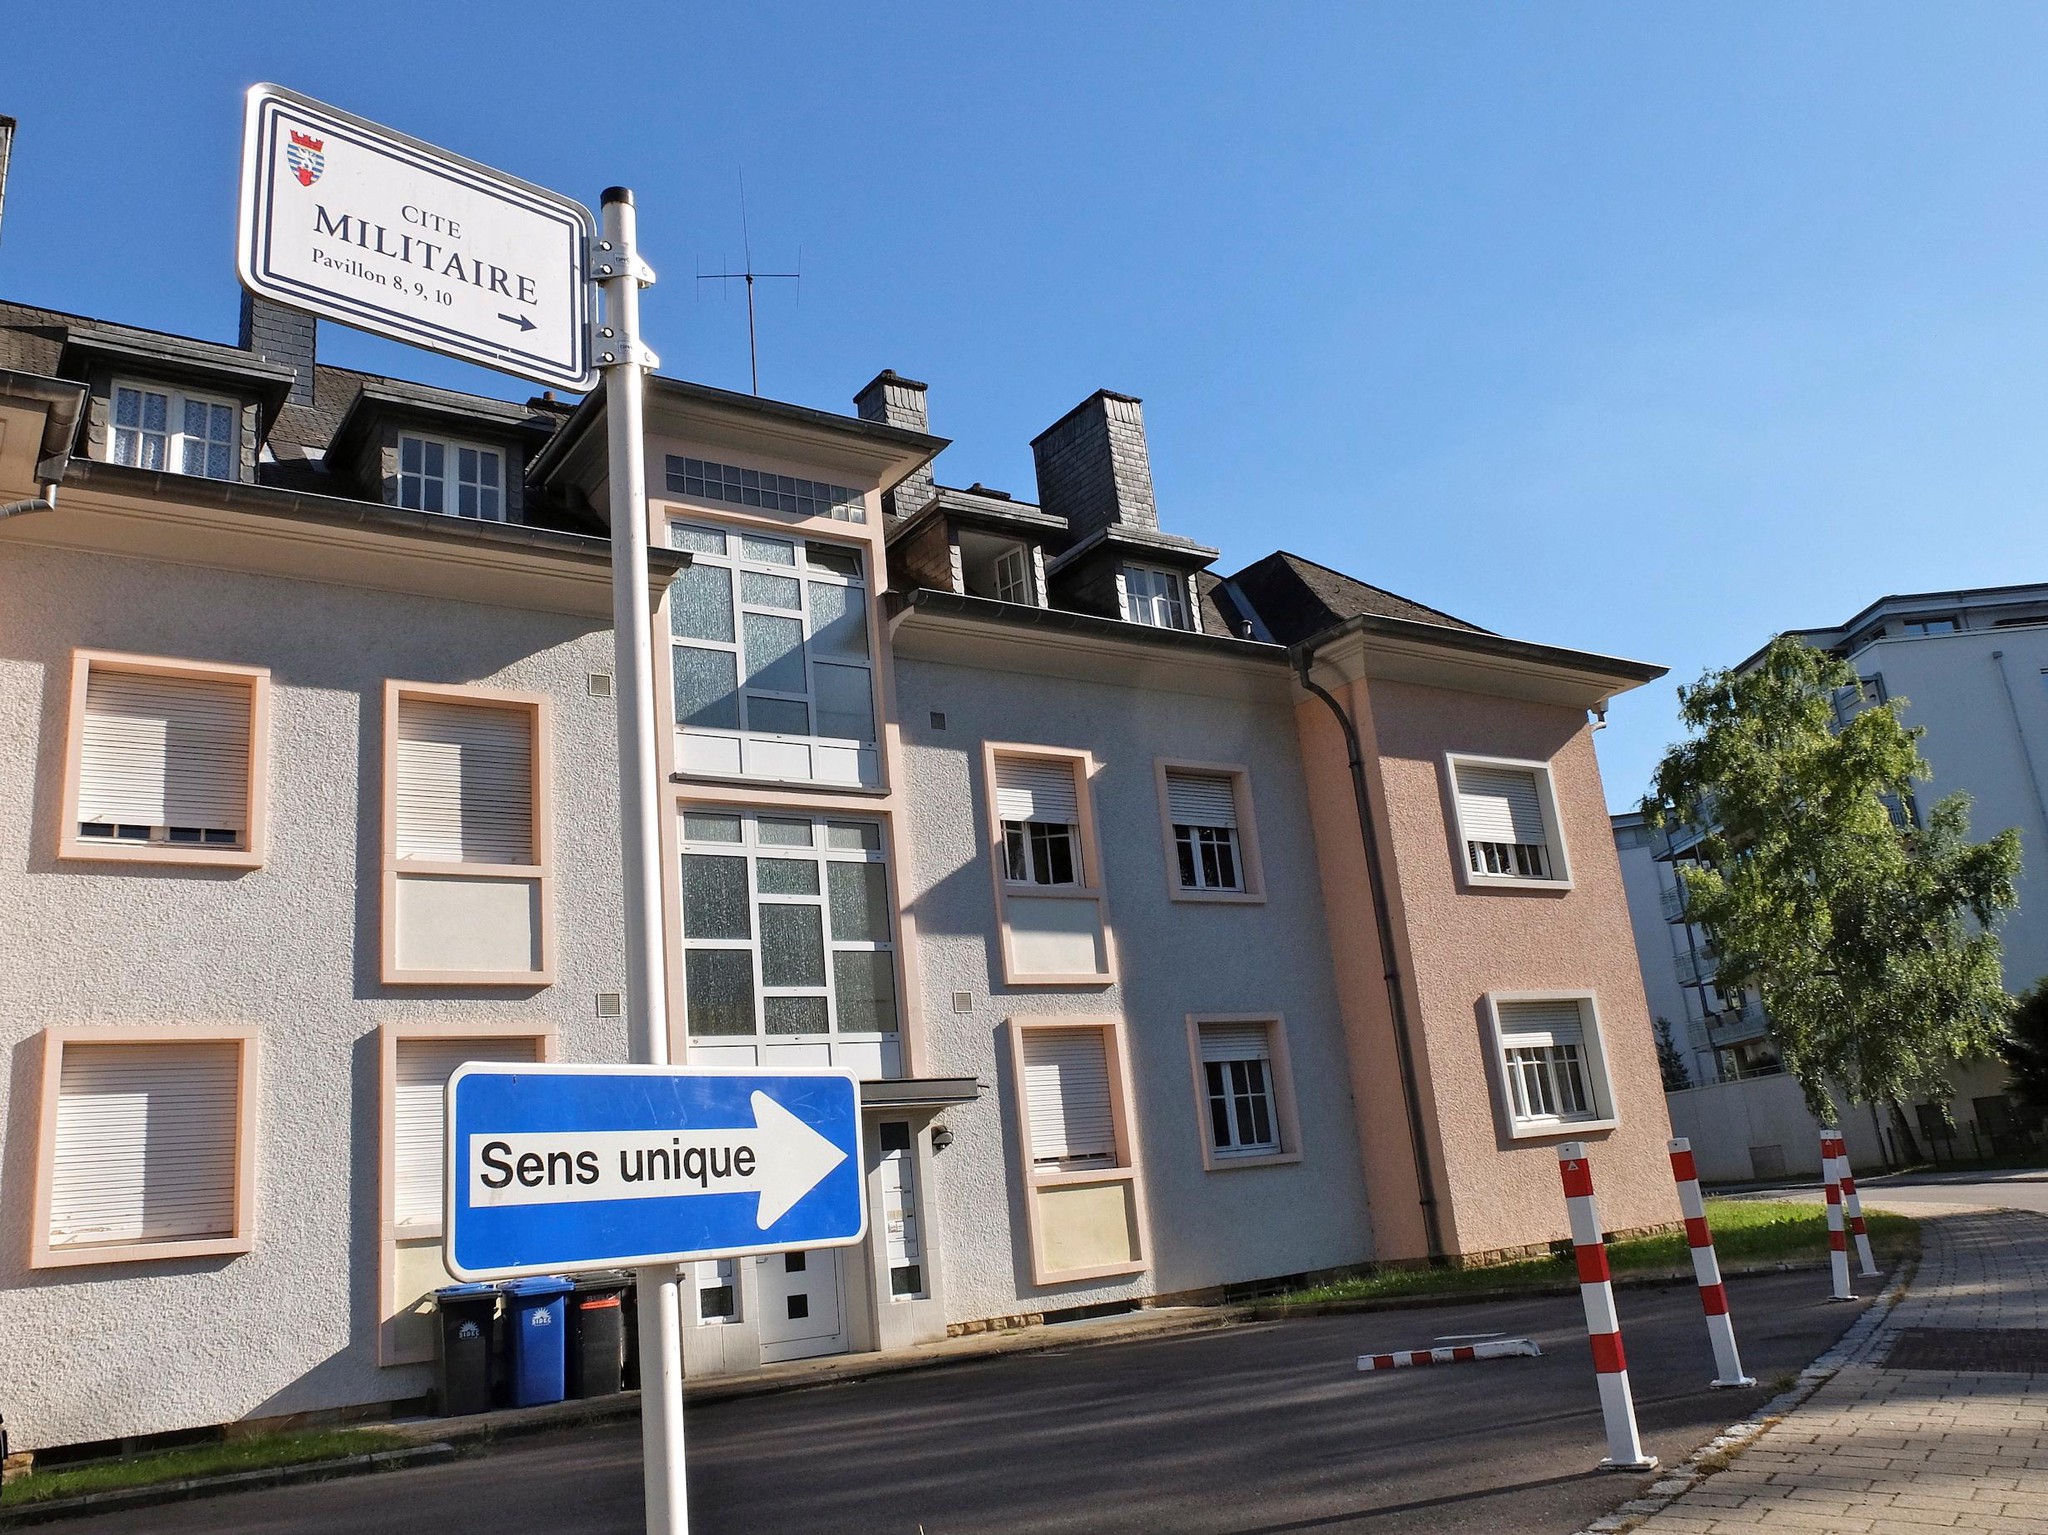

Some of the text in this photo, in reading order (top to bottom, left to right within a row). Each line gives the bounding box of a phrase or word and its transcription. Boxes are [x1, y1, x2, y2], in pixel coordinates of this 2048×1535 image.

[401, 205, 462, 240] CITE
[312, 247, 452, 306] Pavillon 8, 9, 10
[313, 203, 538, 306] MILITAIRE
[480, 1137, 756, 1189] Sens unique
